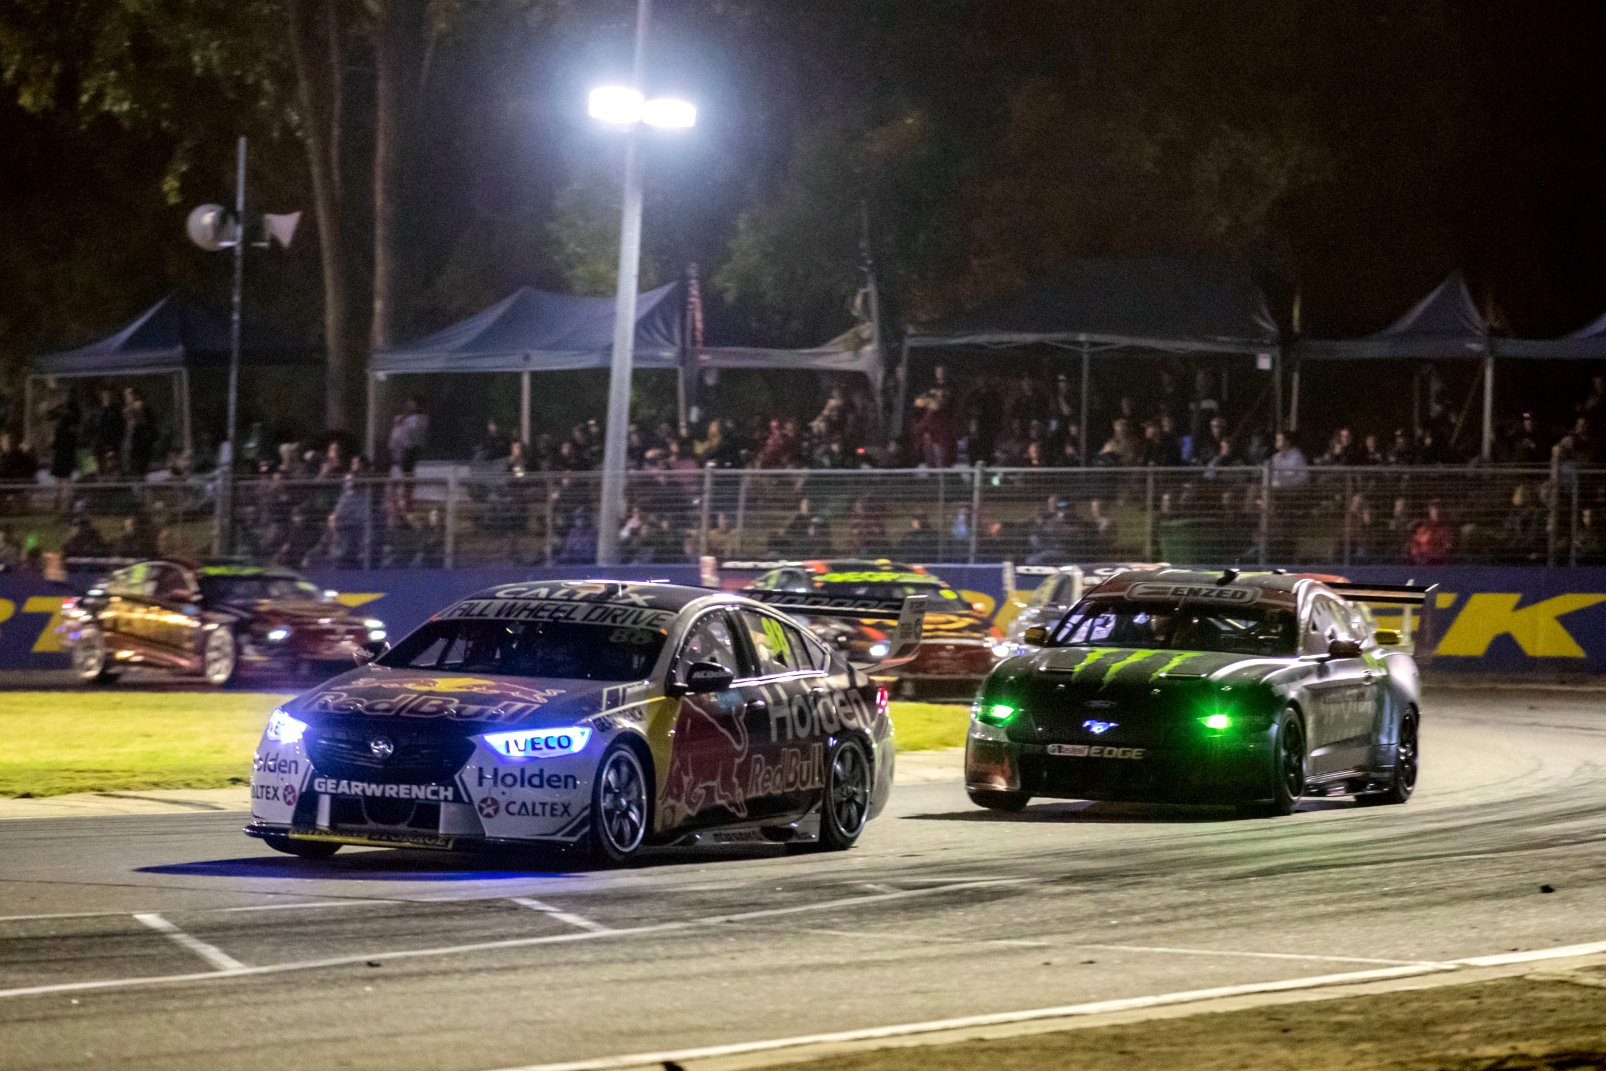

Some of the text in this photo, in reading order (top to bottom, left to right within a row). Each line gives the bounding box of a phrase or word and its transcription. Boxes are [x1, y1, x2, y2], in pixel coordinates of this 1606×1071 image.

[1169, 586, 1248, 600] ENZED
[451, 600, 672, 628] ALL WHEEL DRIVE
[761, 677, 872, 742] Holden
[505, 734, 571, 753] IVECO
[1089, 746, 1145, 759] EDGE
[253, 752, 299, 775] olden
[314, 778, 453, 800] GEARWRENCH
[478, 767, 577, 789] Holden
[505, 801, 571, 817] CALTEX
